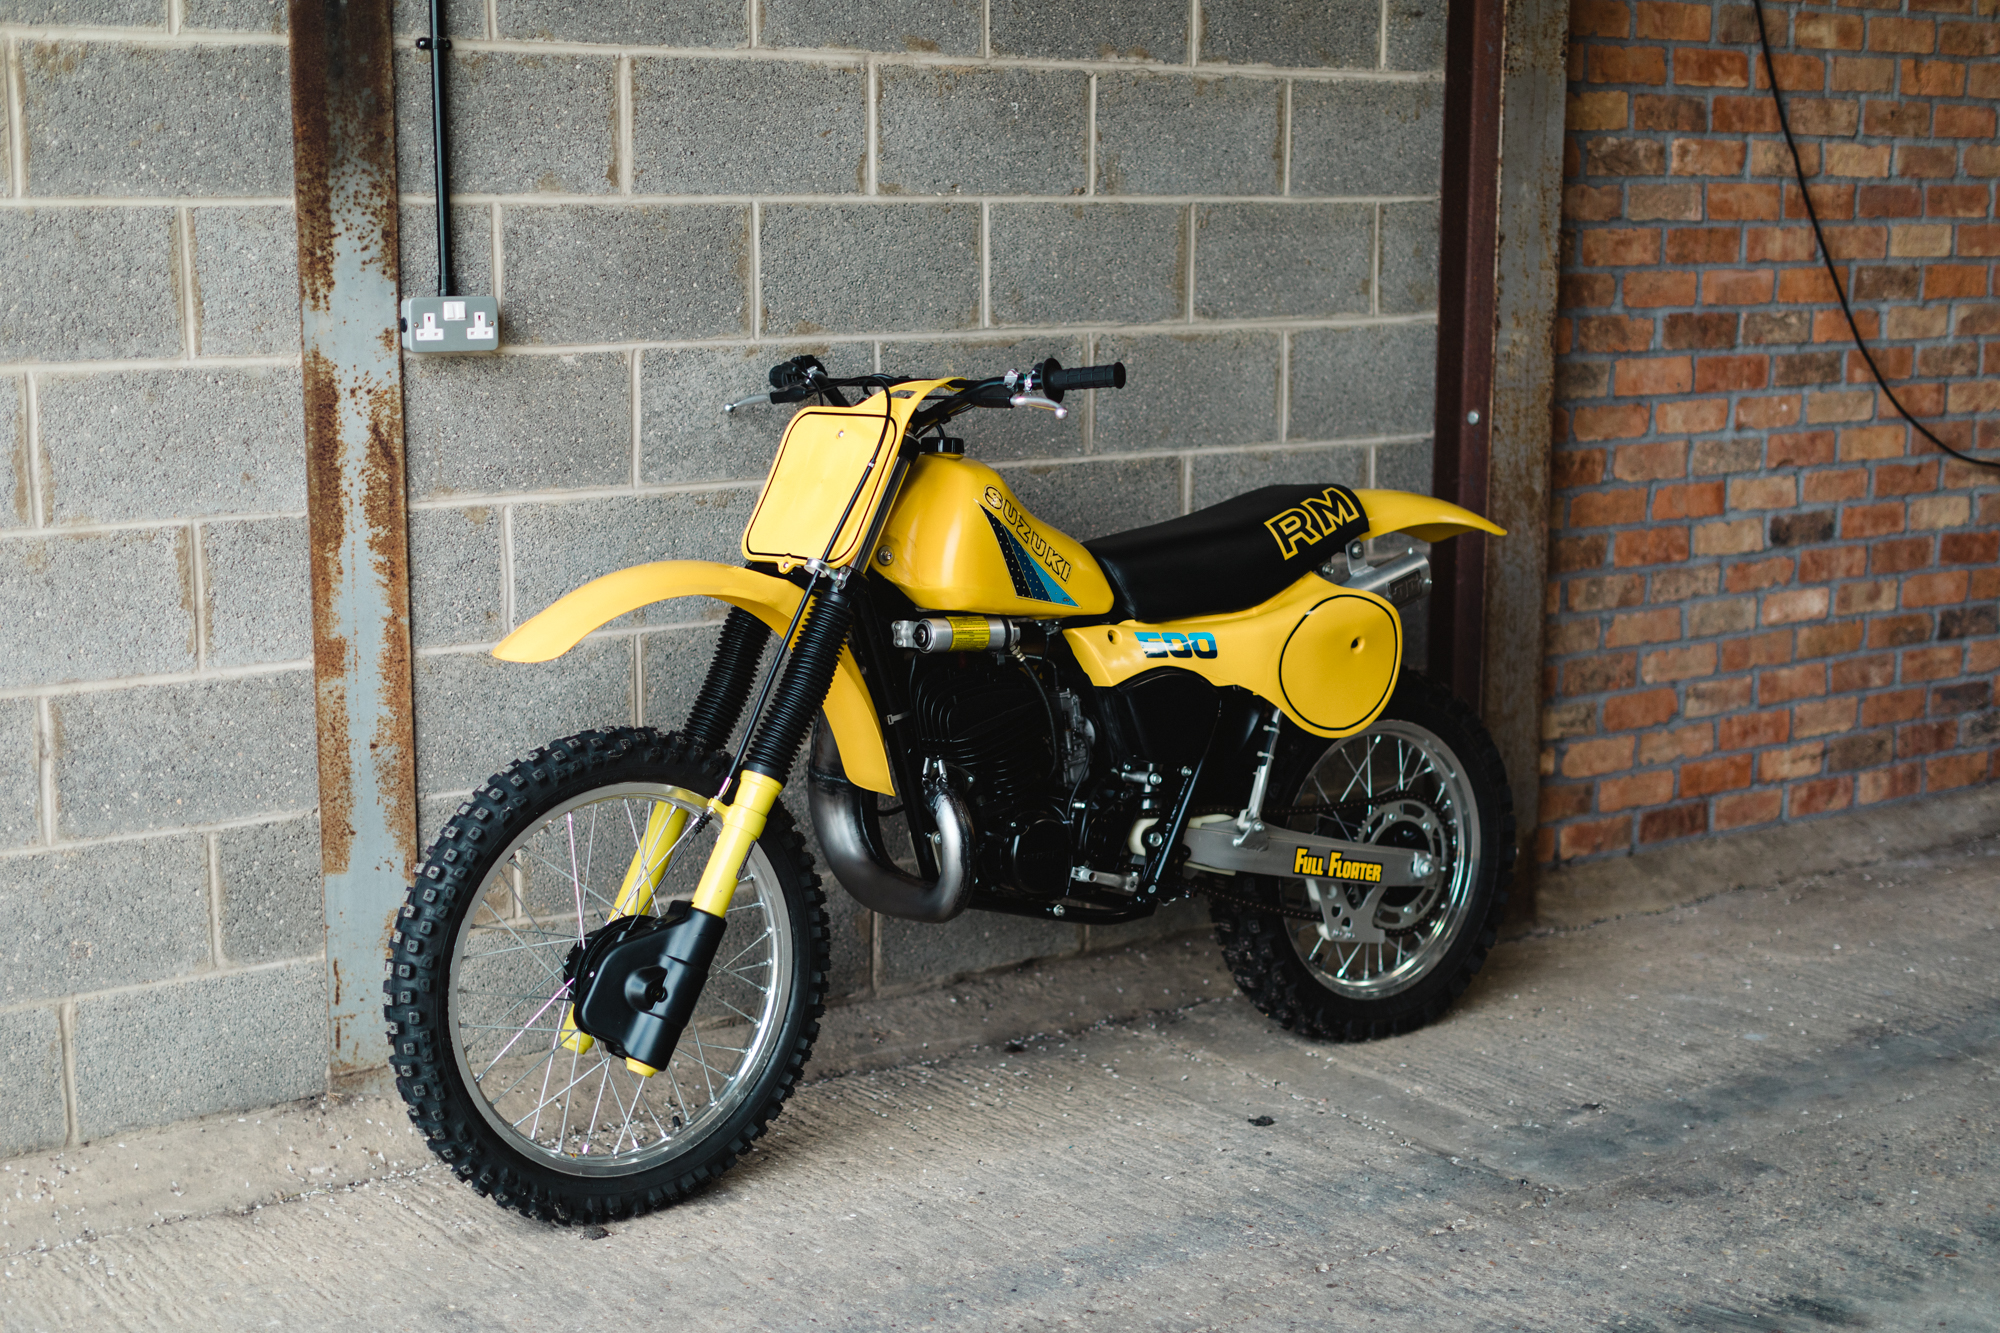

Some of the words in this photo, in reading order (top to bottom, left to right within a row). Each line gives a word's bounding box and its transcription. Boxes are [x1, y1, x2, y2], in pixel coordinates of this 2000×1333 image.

[984, 485, 1071, 583] SUZUKI
[1264, 487, 1360, 561] RM
[1134, 632, 1218, 659] 500
[1294, 847, 1323, 875] FULL
[1328, 852, 1382, 882] FLOATER
